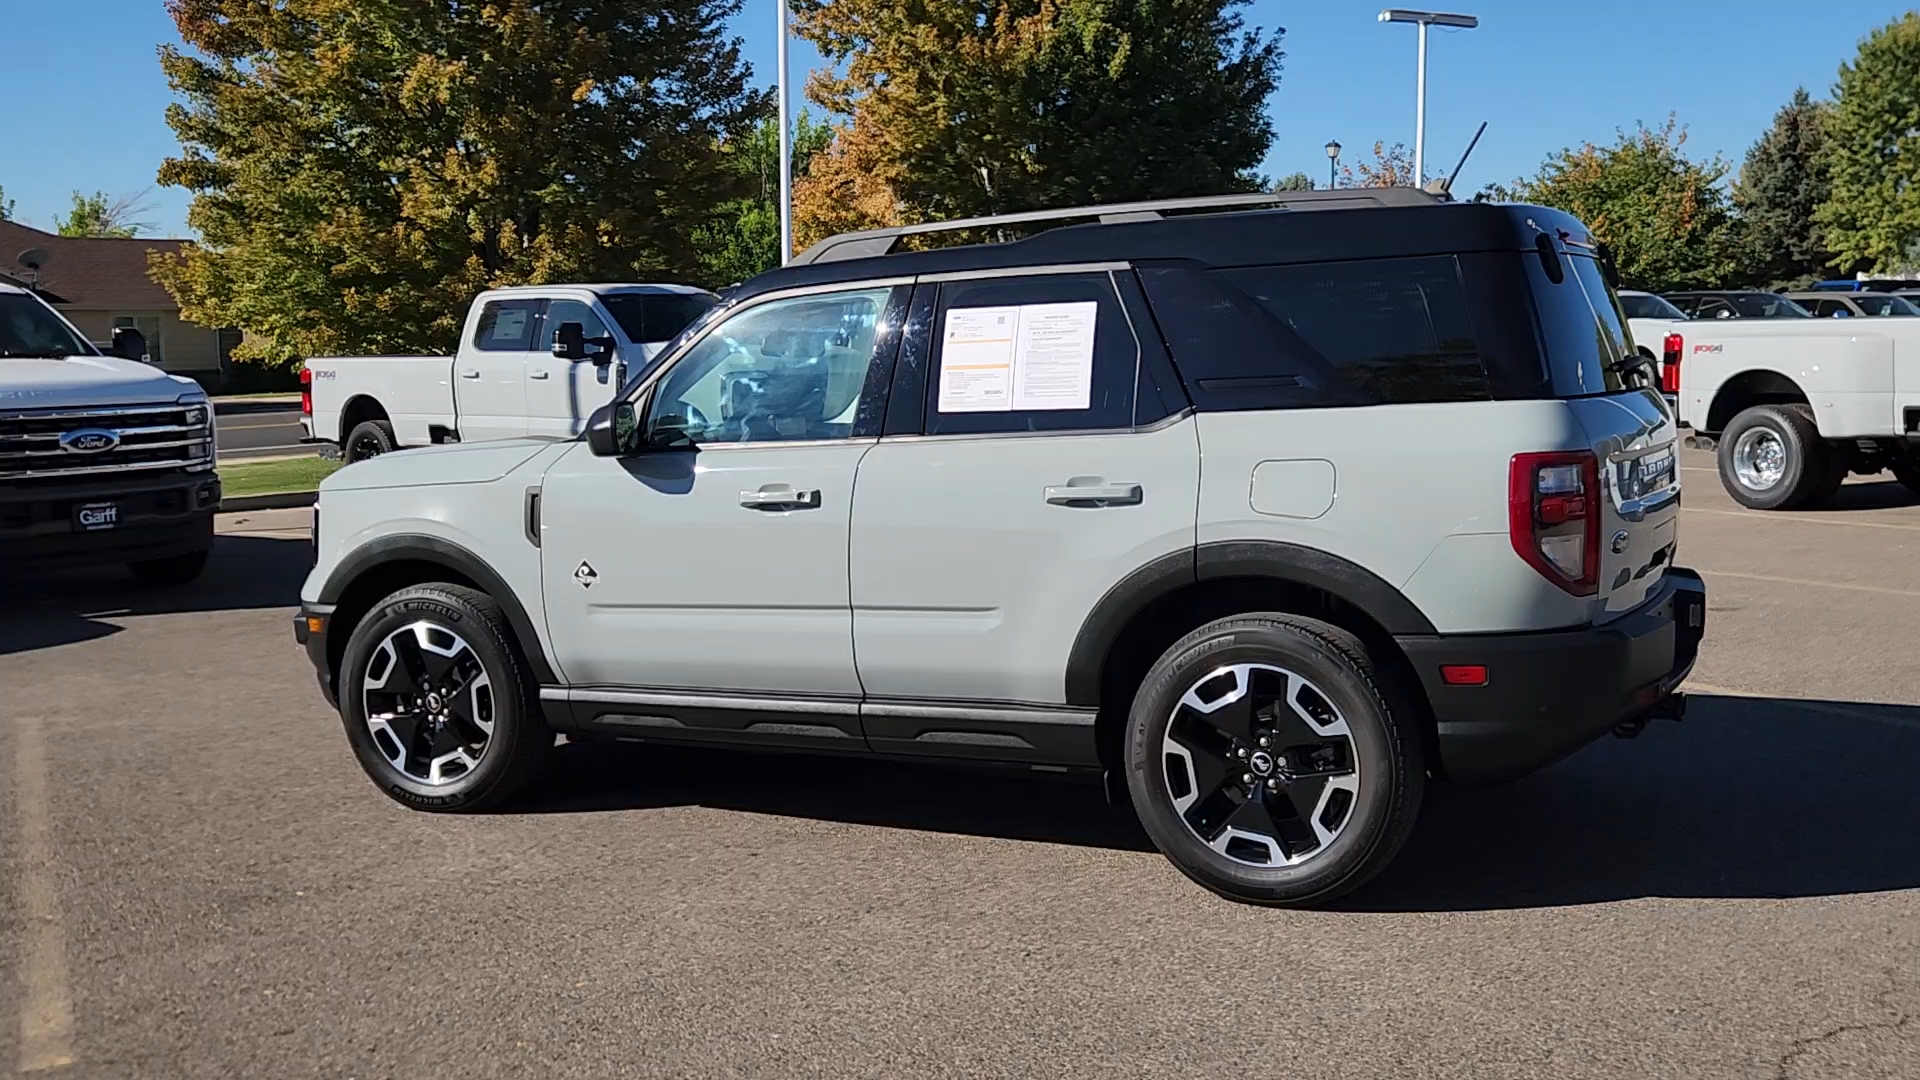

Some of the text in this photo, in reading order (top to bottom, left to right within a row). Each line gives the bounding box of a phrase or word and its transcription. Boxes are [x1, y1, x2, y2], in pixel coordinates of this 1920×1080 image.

[1693, 344, 1723, 355] FX4
[78, 436, 106, 449] Ford
[80, 507, 117, 525] Garff
[407, 602, 461, 621] MICHELIN
